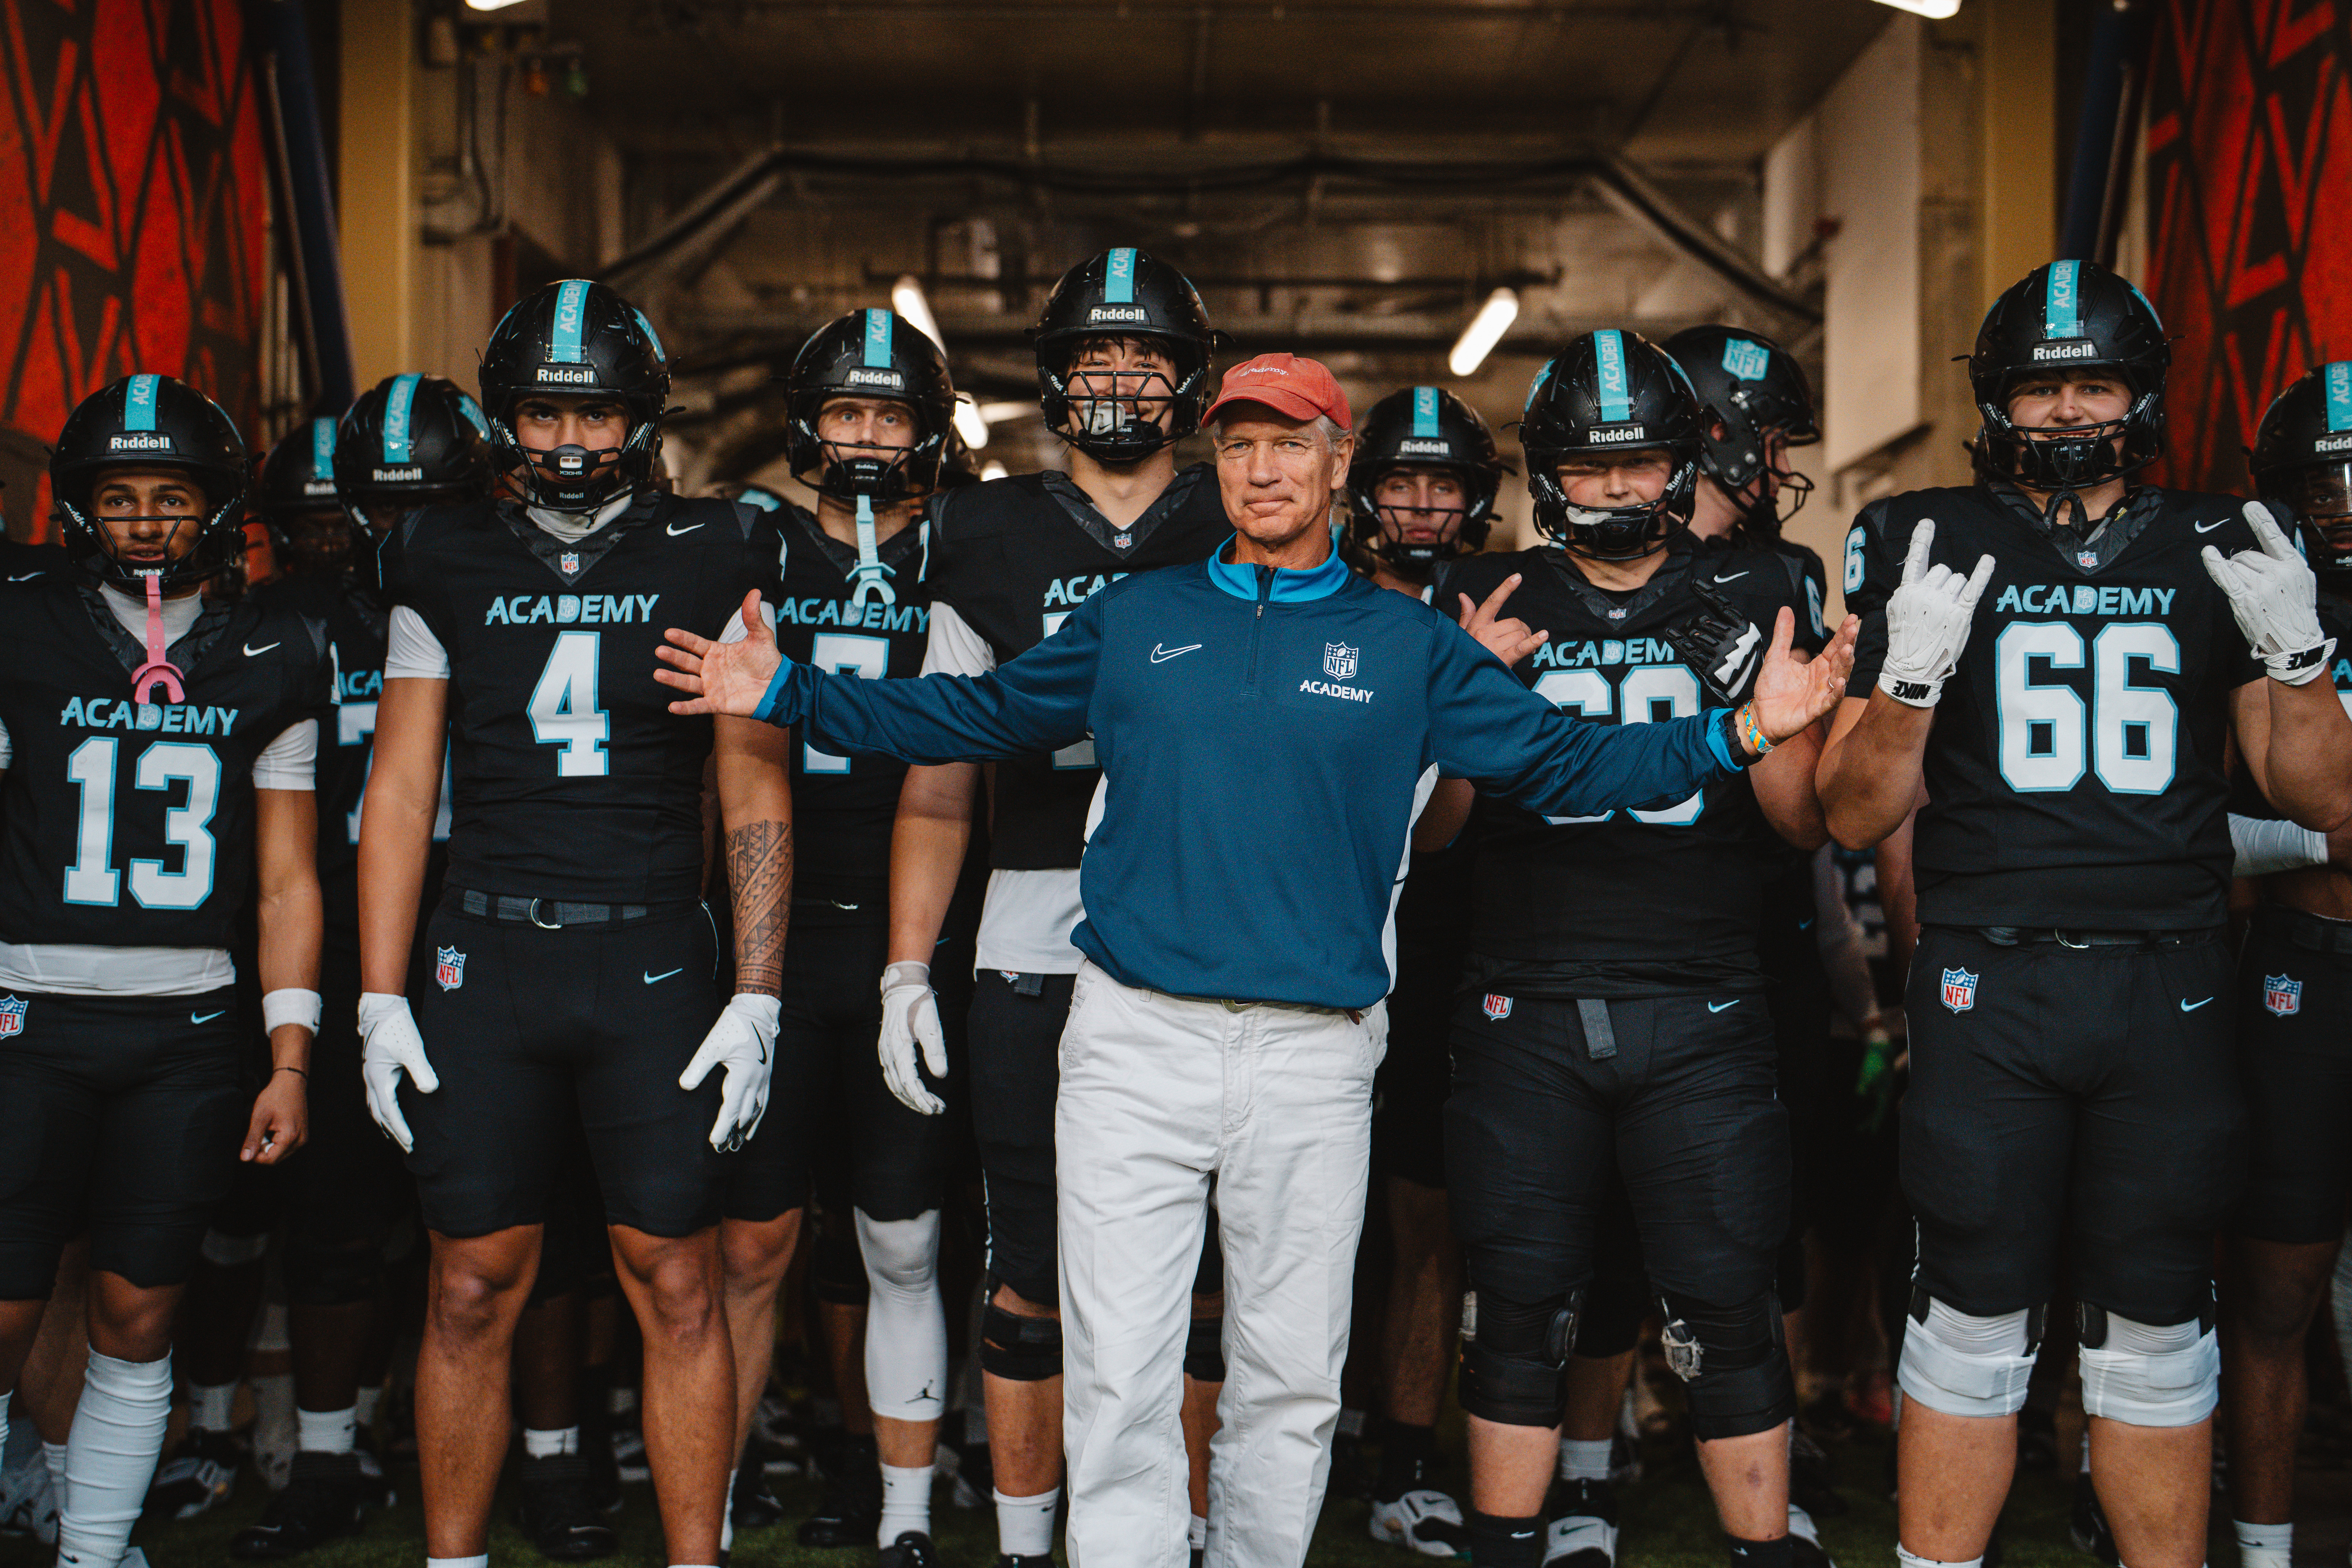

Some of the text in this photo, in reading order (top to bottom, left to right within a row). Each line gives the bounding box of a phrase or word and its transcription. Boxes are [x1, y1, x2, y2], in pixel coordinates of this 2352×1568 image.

[1091, 309, 1145, 320] Riddell
[2034, 345, 2093, 360] Riddell
[537, 369, 593, 383] Riddell
[850, 370, 901, 386] Riddell
[111, 437, 170, 449] Riddell
[1590, 427, 1644, 443] Riddell
[1401, 440, 1449, 454] Riddell
[373, 468, 422, 481] Riddell
[1843, 526, 1866, 595] 6
[1044, 573, 1129, 607] ACA
[1996, 585, 2176, 615] ACADEMY
[485, 594, 660, 625] ACADEMY
[776, 597, 930, 634] ACADEMY
[1532, 638, 1675, 668] ACADEM
[1328, 657, 1353, 675] NFL
[1300, 680, 1374, 703] ACADEMY
[1891, 680, 1931, 700] NIKE
[526, 631, 610, 777] 4
[1996, 621, 2180, 795] 66
[60, 697, 238, 736] ACADEMY
[63, 736, 222, 910] 13
[439, 964, 458, 985] NFL
[1484, 993, 1507, 1014] NFL
[1944, 985, 1970, 1006] NFL
[2267, 991, 2293, 1010] NFL
